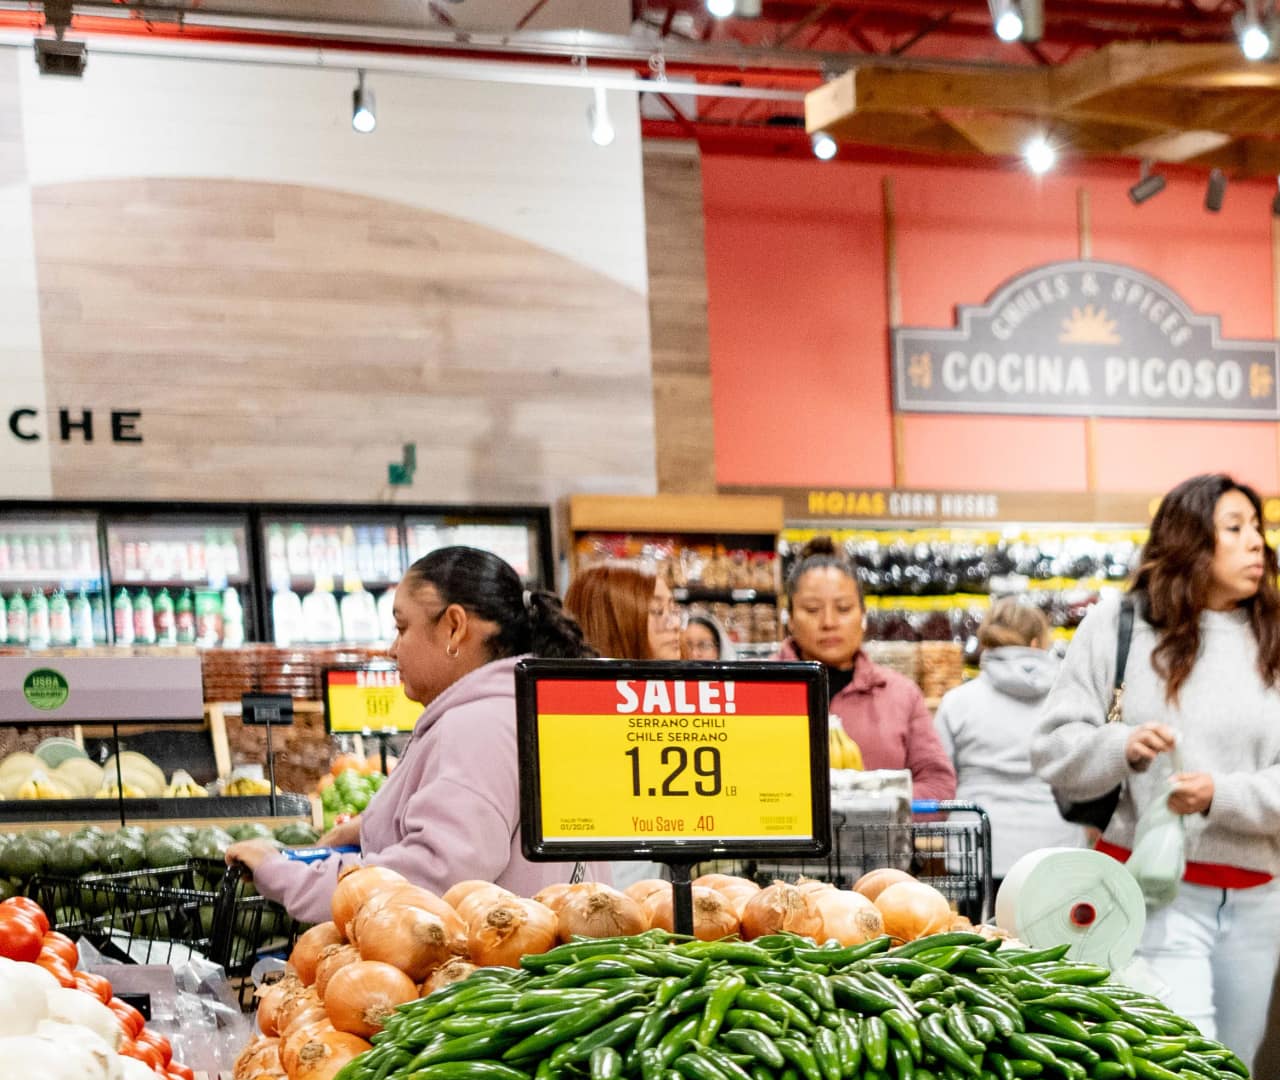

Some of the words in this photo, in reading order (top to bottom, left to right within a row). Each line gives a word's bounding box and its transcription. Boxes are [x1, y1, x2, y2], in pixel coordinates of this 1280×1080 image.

[1080, 271, 1098, 297] &
[1112, 273, 1193, 348] SPICES
[941, 350, 1092, 396] COCINA
[1104, 356, 1244, 400] PICOSO
[9, 408, 144, 443] CHE
[808, 490, 886, 515] HOJAS
[616, 679, 737, 714] SALE!
[626, 732, 664, 743] CHILE
[668, 732, 728, 743] SERRANO
[628, 718, 689, 729] SERRANO
[693, 719, 726, 729] CHILI
[625, 746, 722, 797] 1.29
[726, 786, 737, 797] LB
[632, 816, 653, 832] You
[656, 816, 684, 832] Save
[693, 815, 715, 832] .40
